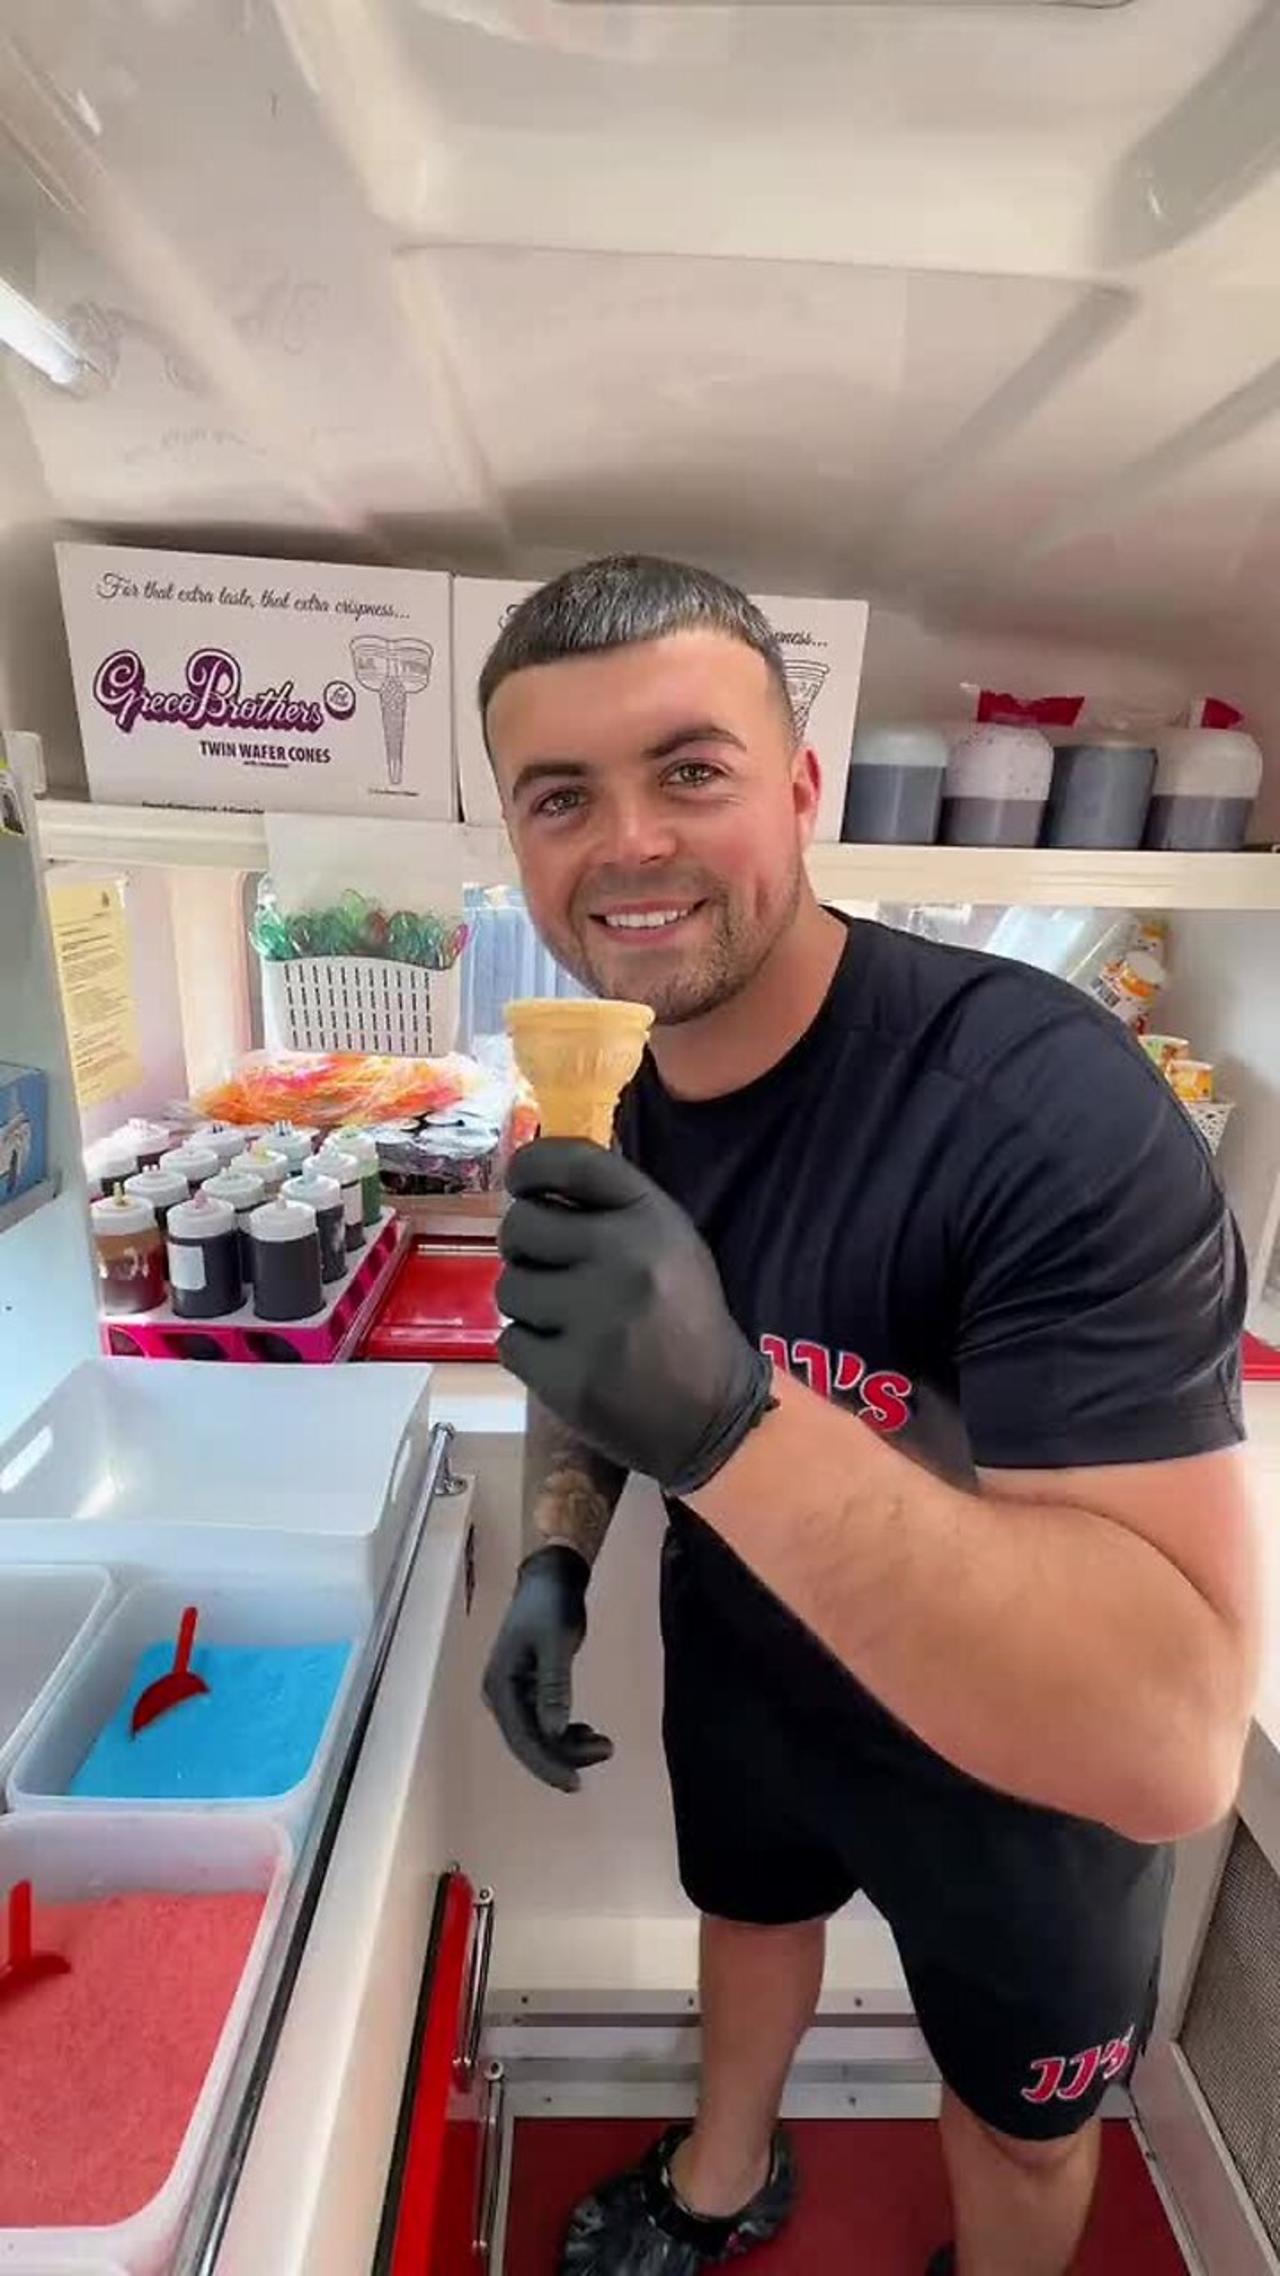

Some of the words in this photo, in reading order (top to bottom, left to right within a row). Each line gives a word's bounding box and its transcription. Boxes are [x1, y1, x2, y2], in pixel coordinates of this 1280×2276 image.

[97, 572, 138, 599] For
[144, 580, 174, 600] that
[178, 585, 213, 603] extra
[260, 589, 290, 608] that
[294, 593, 329, 611] extra
[199, 740, 236, 757] TWIN
[239, 743, 285, 760] WAFER
[288, 747, 331, 763] CONES
